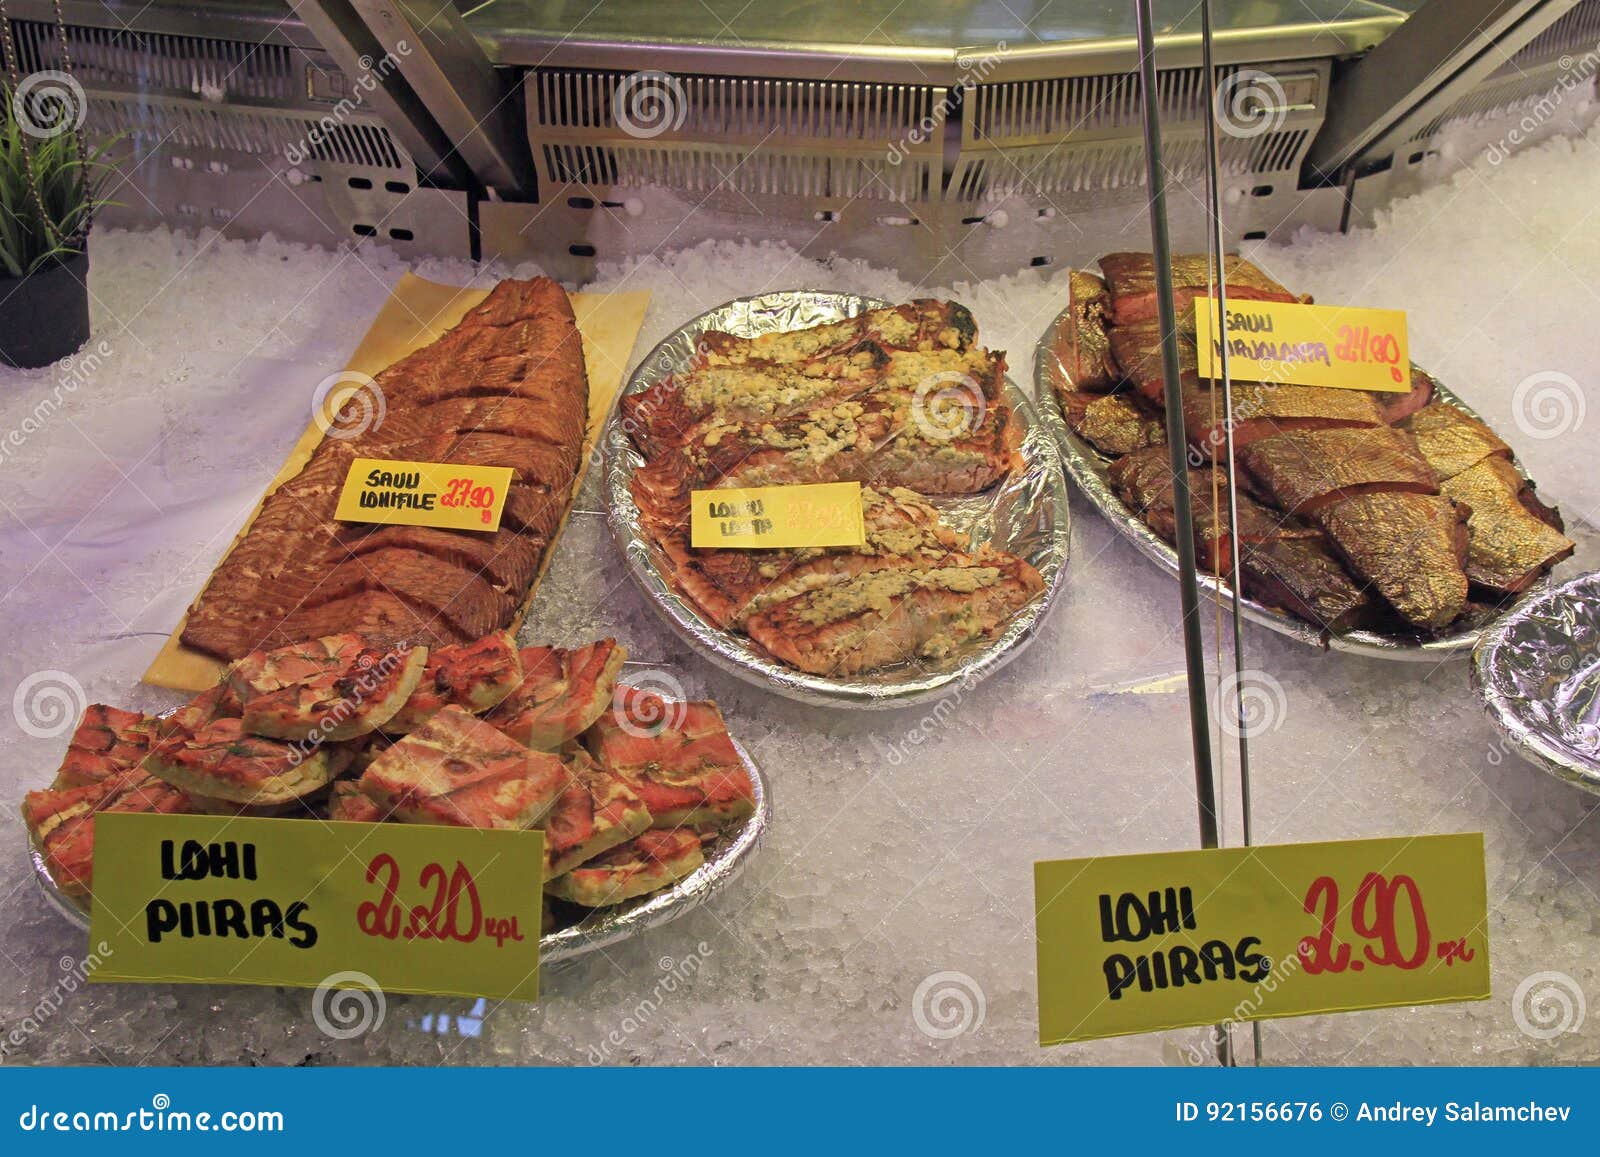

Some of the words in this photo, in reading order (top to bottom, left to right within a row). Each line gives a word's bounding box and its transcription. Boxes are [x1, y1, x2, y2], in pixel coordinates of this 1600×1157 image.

[160, 839, 257, 881] LOHI
[145, 899, 318, 949] PIIRAS
[357, 853, 482, 943] 2.20
[1098, 886, 1197, 942] LOHI
[1297, 872, 1431, 975] 2.90
[1102, 936, 1271, 1000] PIIRAS
